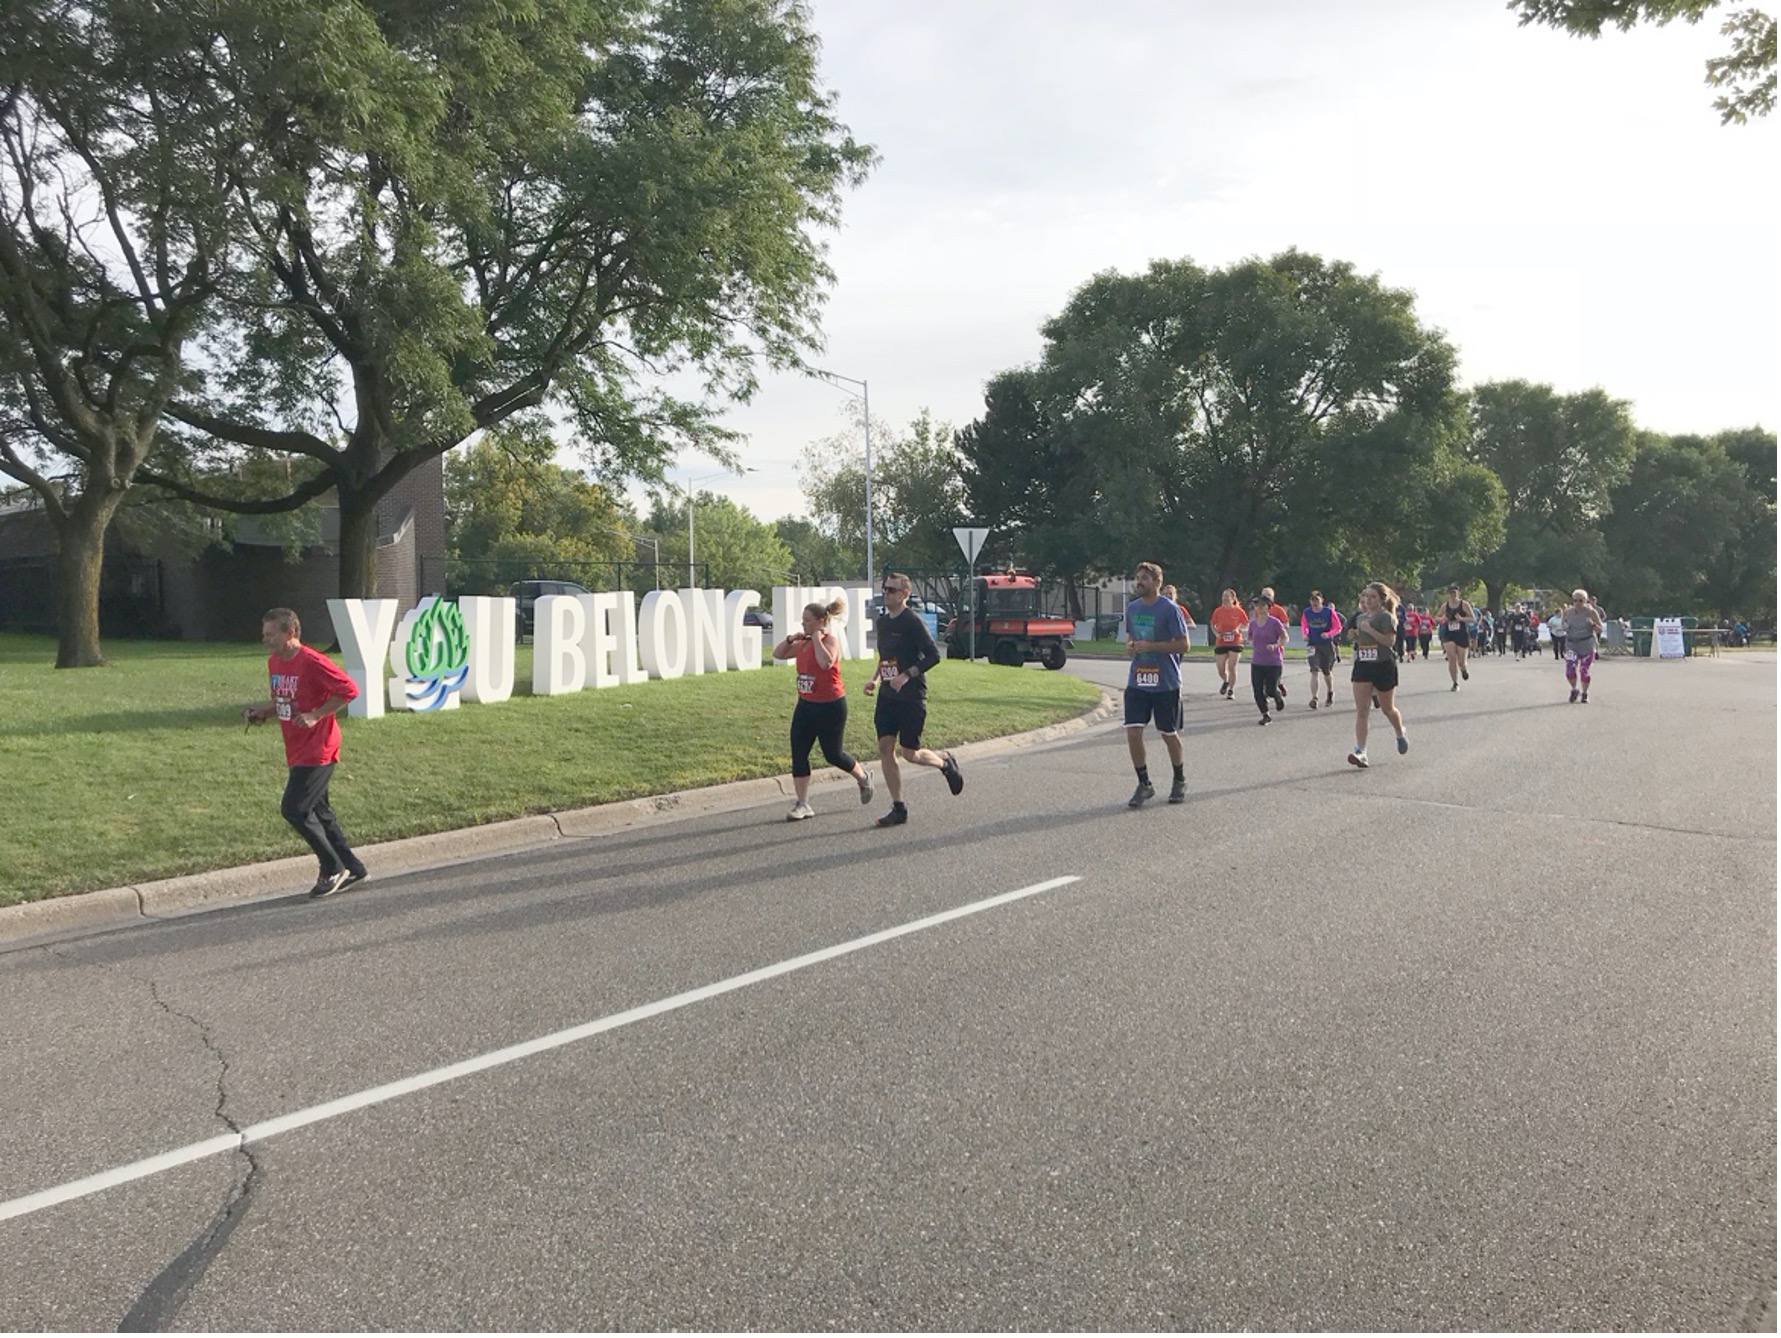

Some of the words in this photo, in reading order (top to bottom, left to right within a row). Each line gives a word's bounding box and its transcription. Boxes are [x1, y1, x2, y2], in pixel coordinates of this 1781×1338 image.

[533, 588, 762, 697] BELONG
[772, 586, 875, 666] HRE
[1136, 672, 1159, 684] 6400
